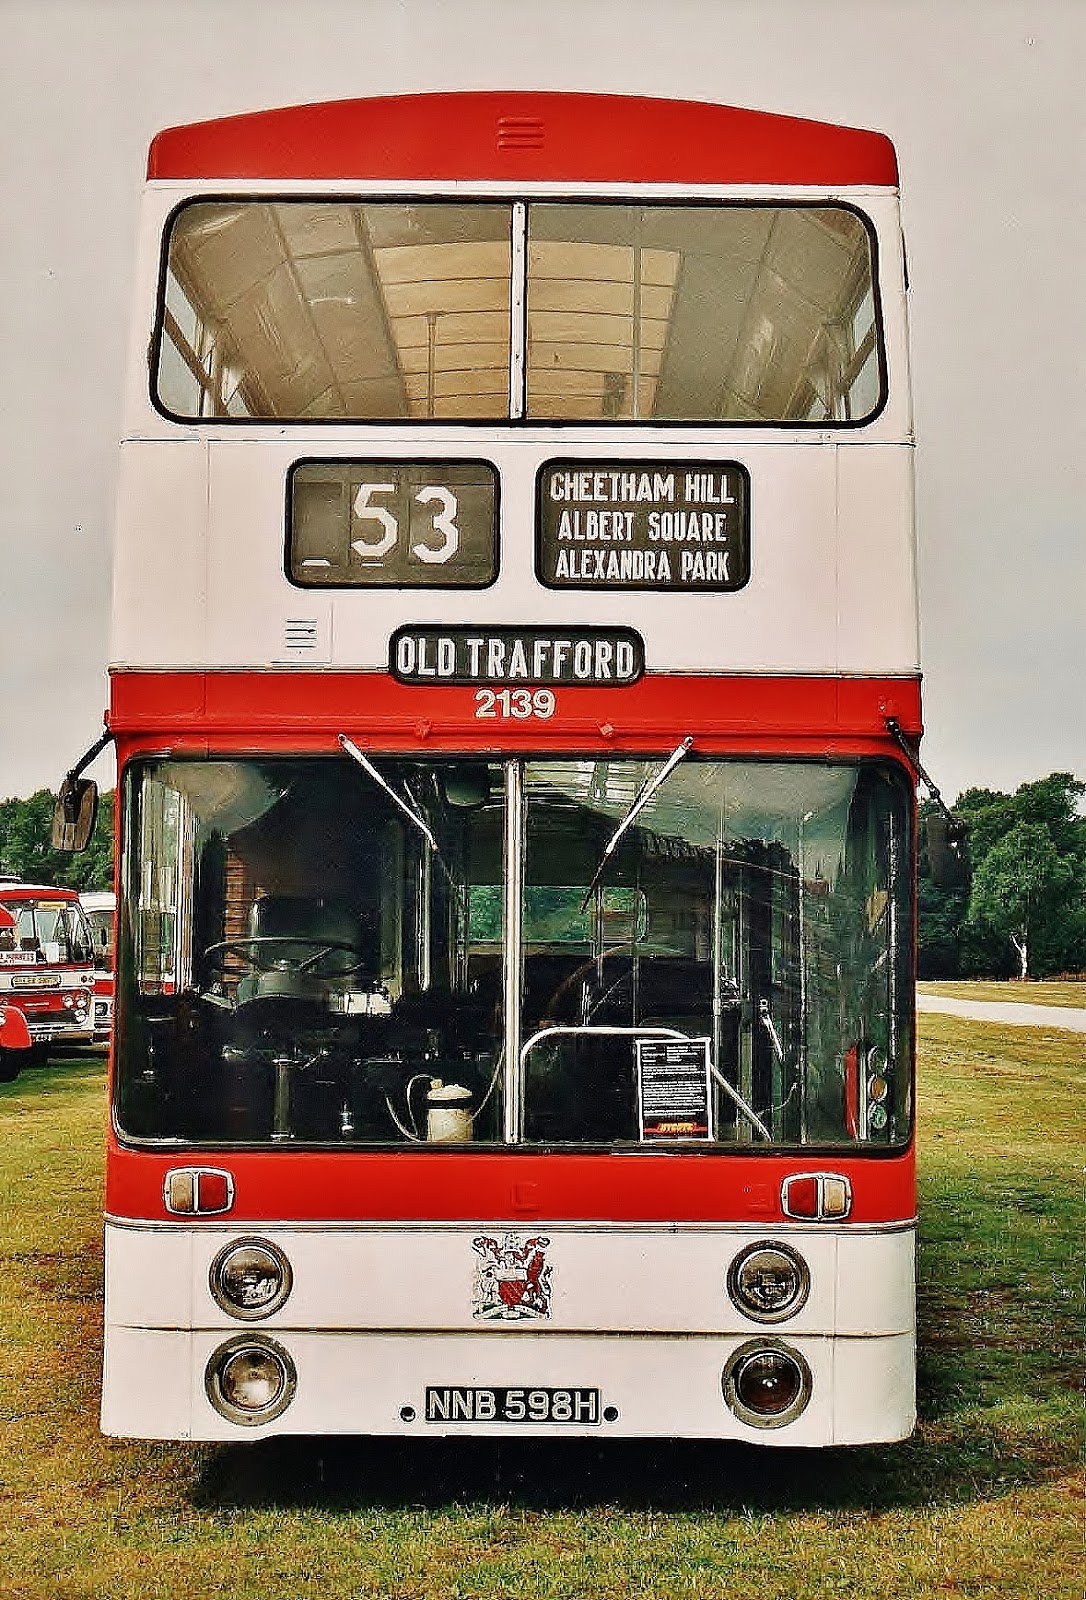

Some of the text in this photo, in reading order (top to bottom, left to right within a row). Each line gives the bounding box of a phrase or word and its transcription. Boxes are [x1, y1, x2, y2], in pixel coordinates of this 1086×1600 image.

[550, 472, 735, 504] CHEETHAM HILL
[352, 483, 459, 565] 53
[557, 511, 727, 543] ALBERT SQUARE
[555, 549, 730, 582] ALEXANDRA PARK
[397, 637, 634, 679] OLD TRAFFORD
[473, 688, 556, 719] 2139
[429, 1390, 596, 1421] NNB 598H
